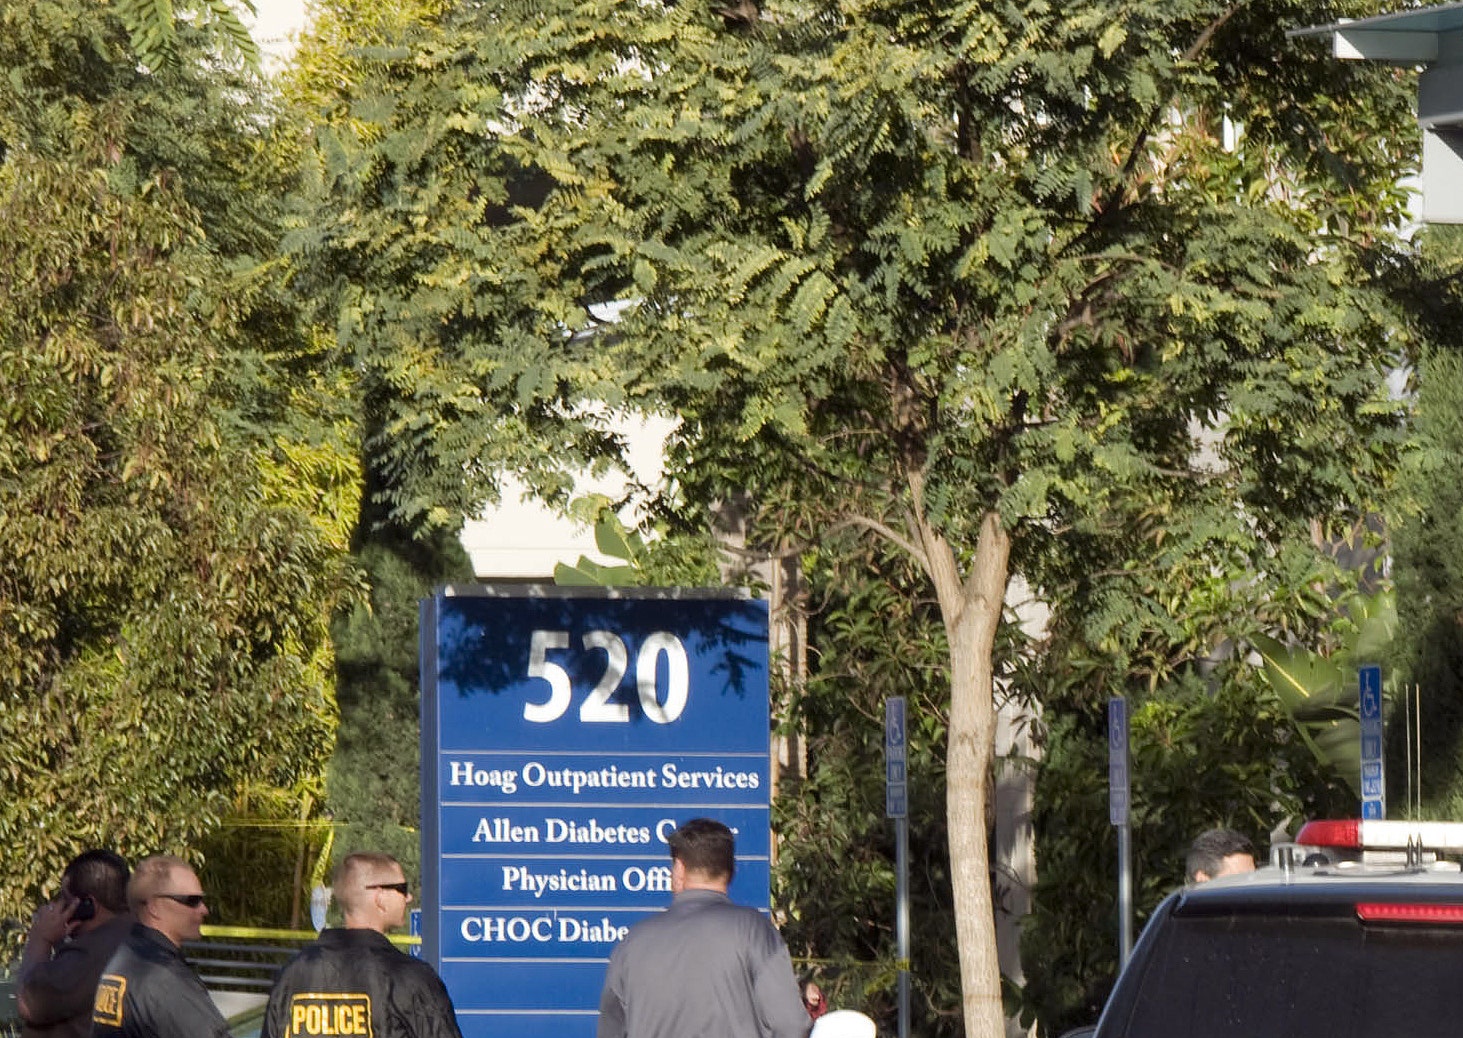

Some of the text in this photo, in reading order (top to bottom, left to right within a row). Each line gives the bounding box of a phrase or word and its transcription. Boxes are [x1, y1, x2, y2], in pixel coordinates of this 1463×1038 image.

[523, 630, 690, 724] 520
[449, 761, 760, 794] Hoag Outpatient Services
[472, 818, 540, 843] Allen
[545, 818, 651, 844] Diabetes
[501, 866, 673, 898] Physician Offi
[460, 916, 630, 943] CHOC Diabe
[292, 1004, 367, 1036] POLICE
